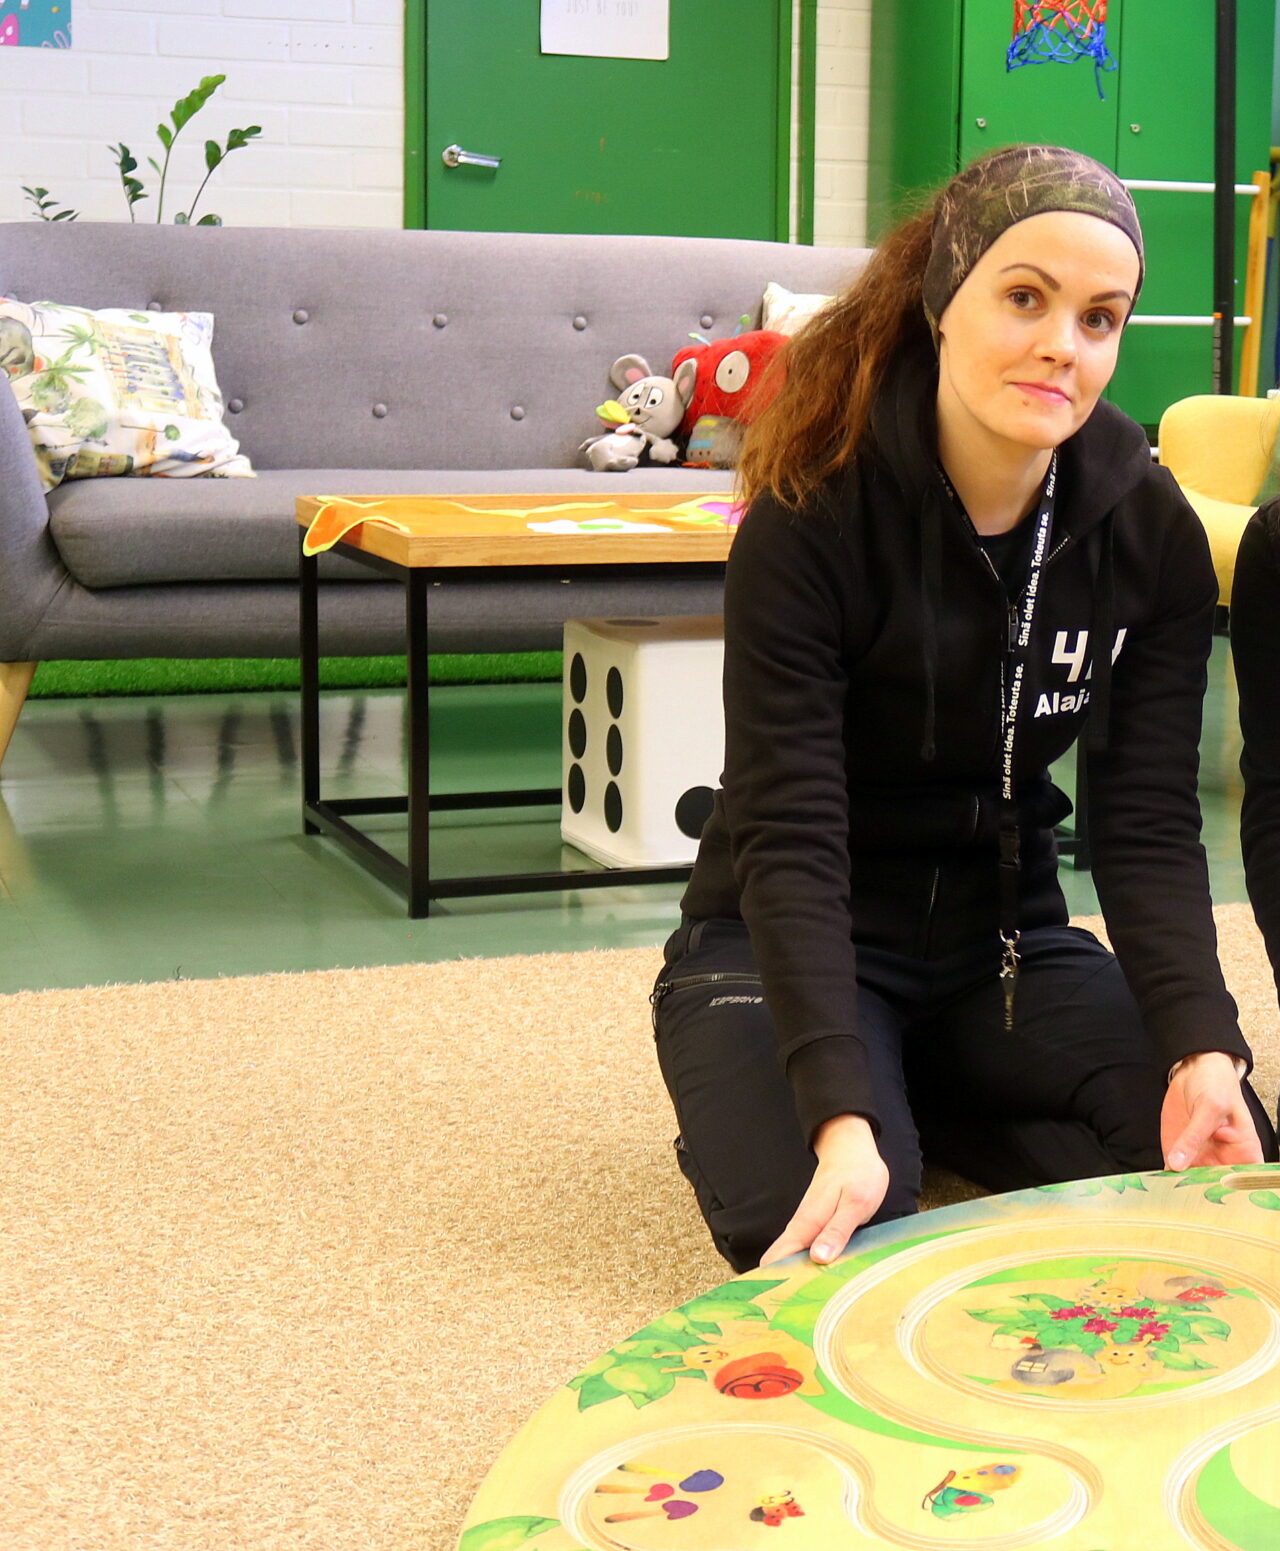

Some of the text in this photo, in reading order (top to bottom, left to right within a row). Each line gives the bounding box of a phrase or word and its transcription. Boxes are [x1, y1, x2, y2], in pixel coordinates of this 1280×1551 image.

[1018, 511, 1050, 647] Sinä olet idea. Toteuta se.
[1014, 662, 1024, 680] se.
[1006, 680, 1021, 724] Toteuta
[1034, 687, 1091, 718] Alaj
[1003, 753, 1012, 776] olet
[1002, 776, 1011, 800] Sinä
